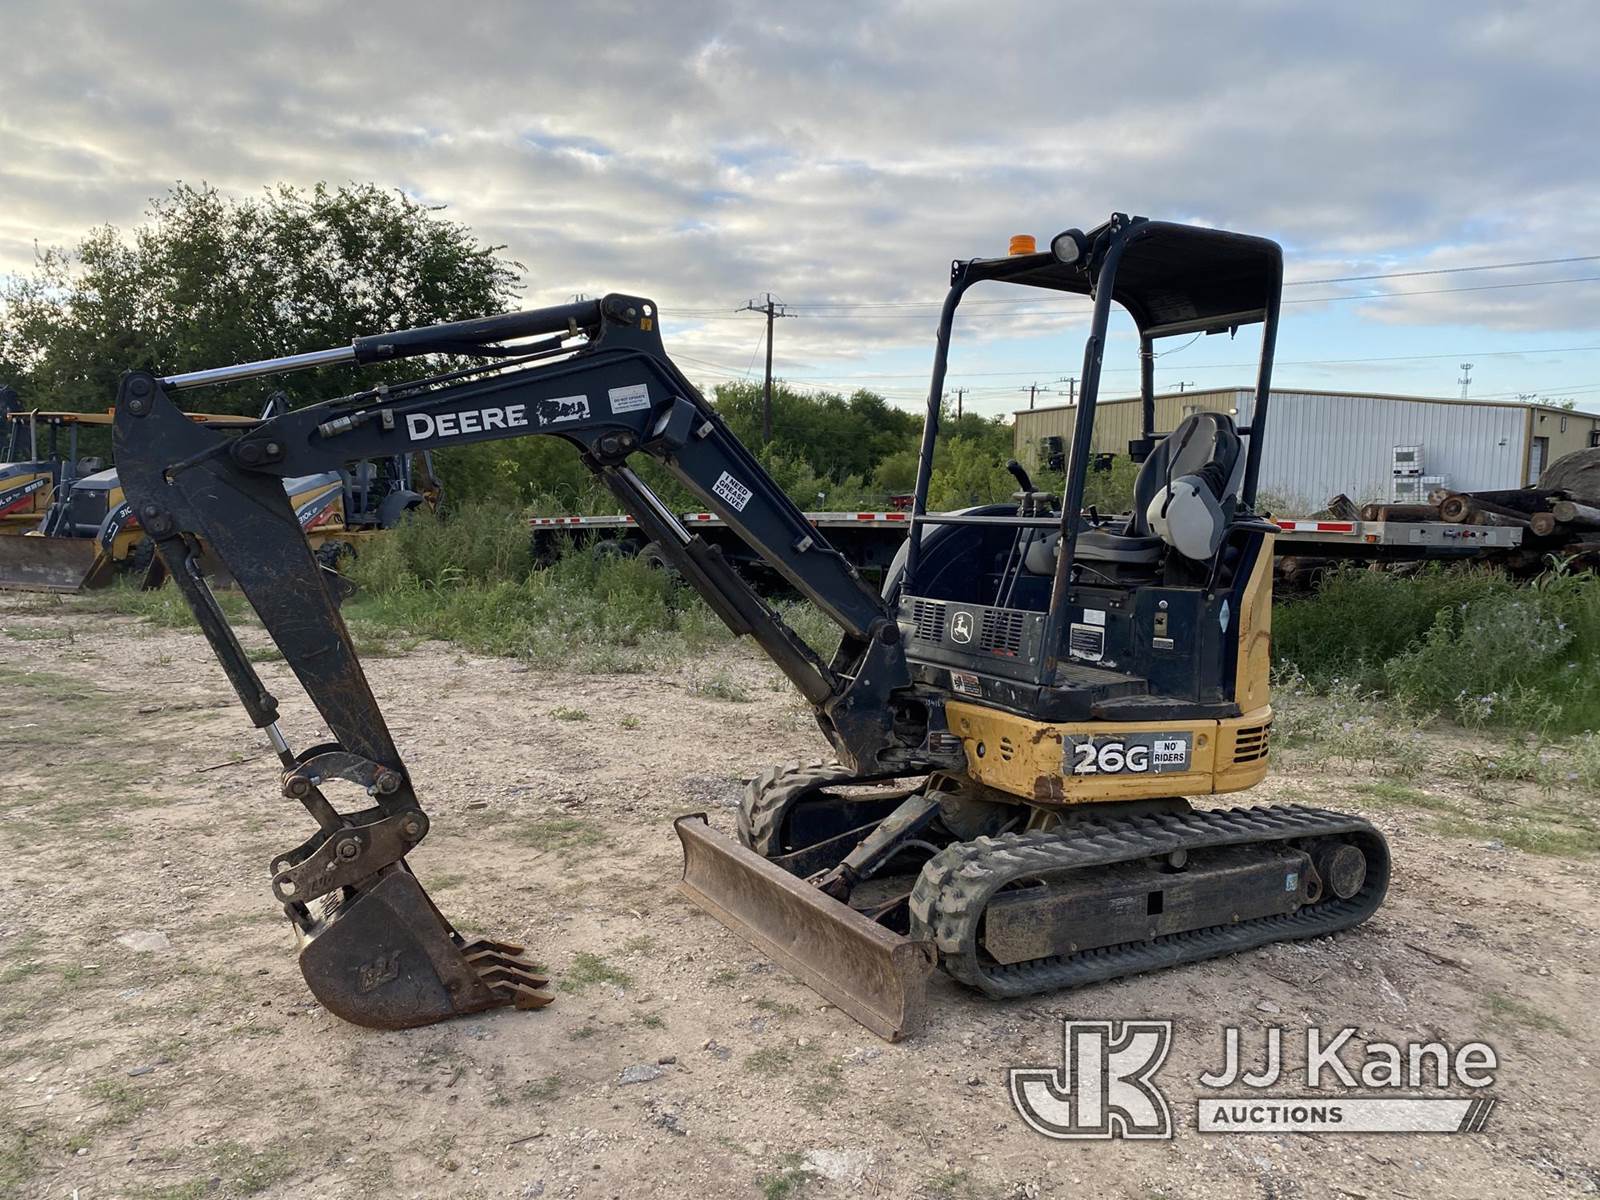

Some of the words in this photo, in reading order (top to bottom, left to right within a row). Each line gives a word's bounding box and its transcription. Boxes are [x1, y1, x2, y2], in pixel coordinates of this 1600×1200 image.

[405, 404, 529, 441] DEERE
[714, 484, 725, 495] TO
[724, 493, 743, 510] LIVE!
[719, 480, 747, 504] GREASE
[729, 479, 748, 496] NEED
[1073, 742, 1149, 774] 26G
[1154, 753, 1185, 762] RIDERS
[1164, 742, 1177, 751] NO
